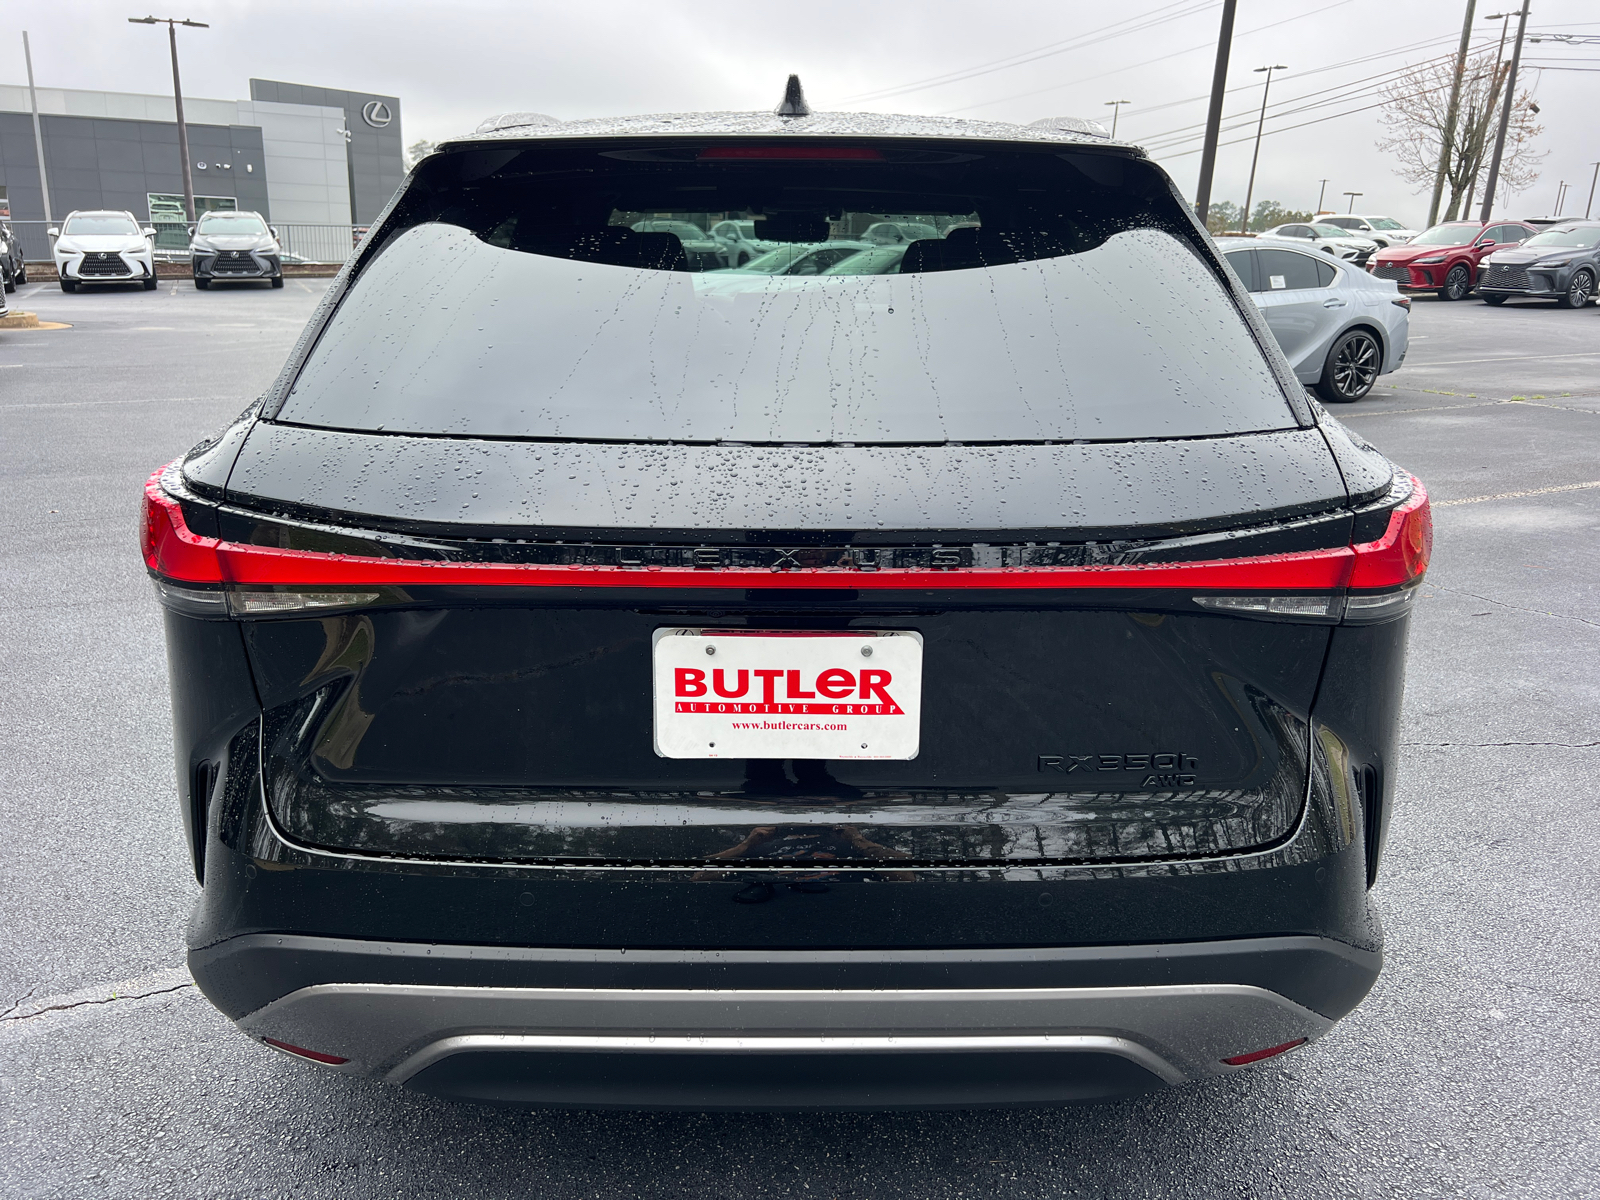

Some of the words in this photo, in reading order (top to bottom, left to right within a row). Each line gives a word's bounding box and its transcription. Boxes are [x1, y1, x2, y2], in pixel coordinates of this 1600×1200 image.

[615, 547, 961, 567] LEXUS
[675, 702, 808, 714] AUTOMOTIVE
[832, 704, 897, 714] GROUP
[732, 720, 848, 731] www.butlercars.com
[1139, 773, 1198, 789] AWD
